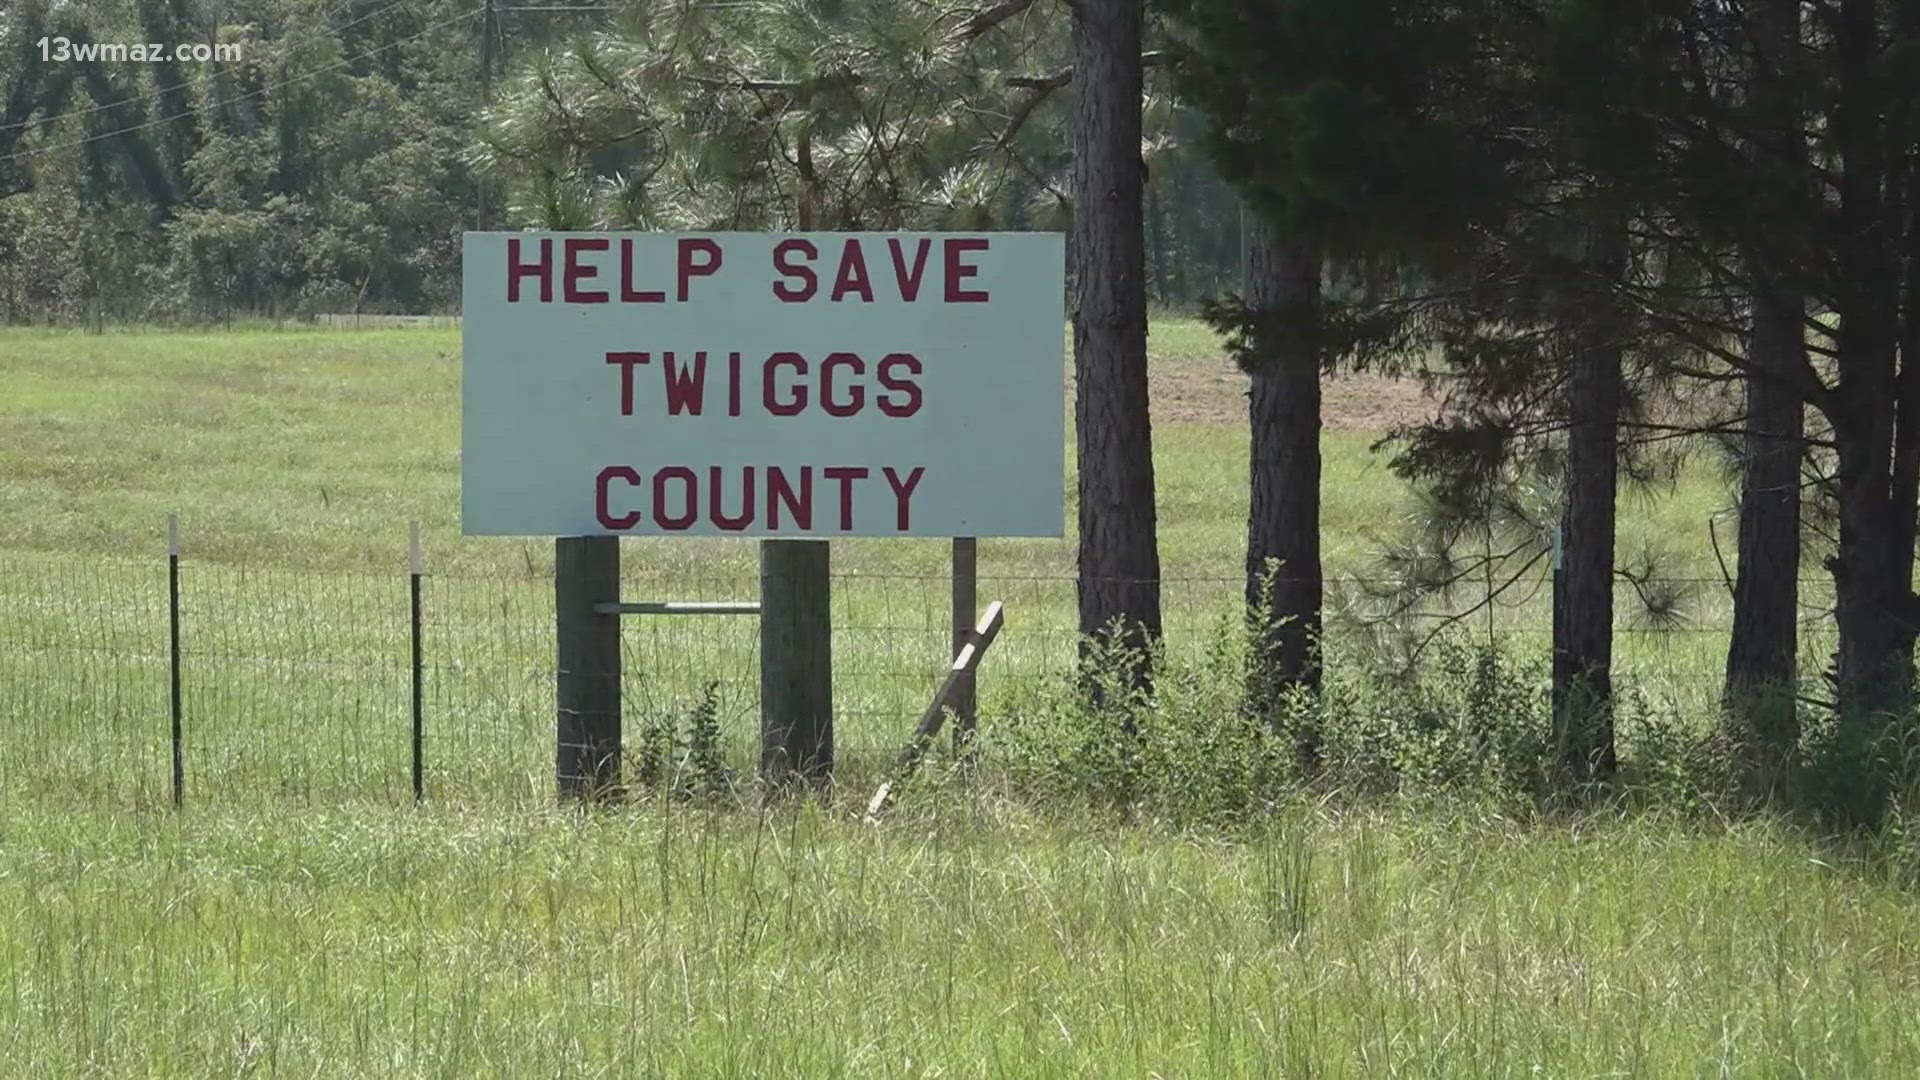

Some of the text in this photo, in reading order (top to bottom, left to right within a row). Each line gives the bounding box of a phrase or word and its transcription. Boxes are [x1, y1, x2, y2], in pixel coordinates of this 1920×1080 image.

[507, 238, 990, 303] HELP SAVE
[605, 351, 923, 417] TWIGGS
[595, 466, 926, 531] COUNTY
